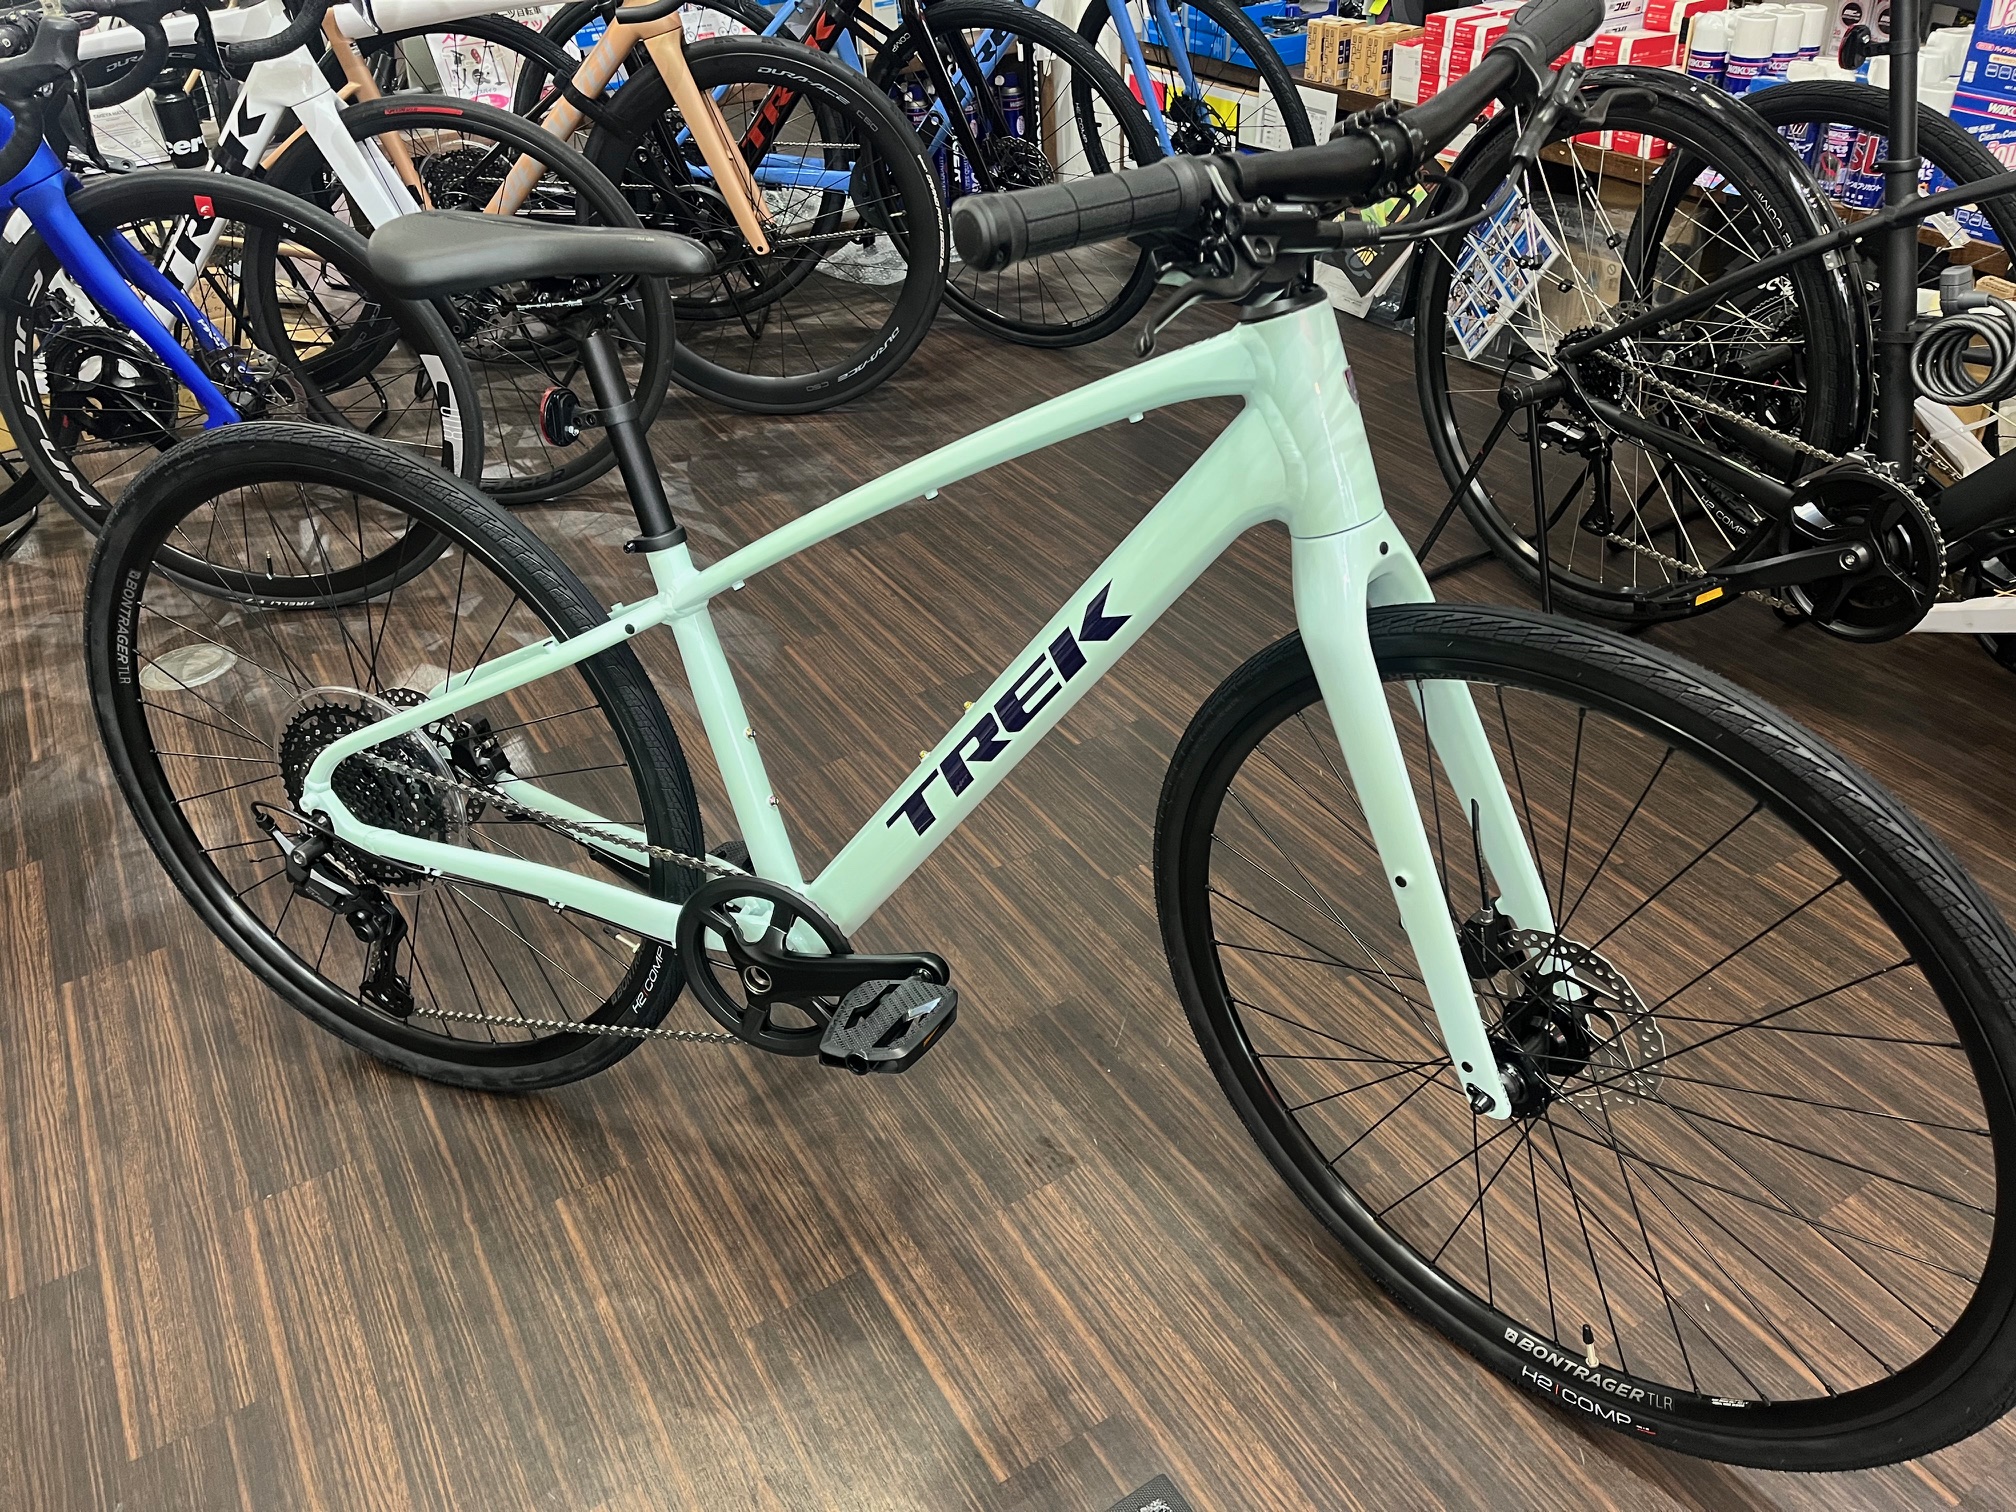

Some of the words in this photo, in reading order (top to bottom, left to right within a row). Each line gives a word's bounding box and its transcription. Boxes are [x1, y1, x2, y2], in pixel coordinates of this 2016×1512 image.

[757, 66, 850, 106] DURA-ACE
[838, 326, 900, 383] DURA-ACE
[1716, 510, 1746, 535] COMP
[116, 578, 138, 664] BONTRAGER
[117, 665, 131, 684] TLR
[886, 579, 1132, 836] TREK
[632, 992, 647, 1014] H2
[645, 945, 663, 992] COMP
[1516, 1337, 1645, 1402] BONTRAGER
[1647, 1392, 1673, 1411] TLR
[1522, 1365, 1553, 1392] H2
[1561, 1388, 1632, 1425] COMP
